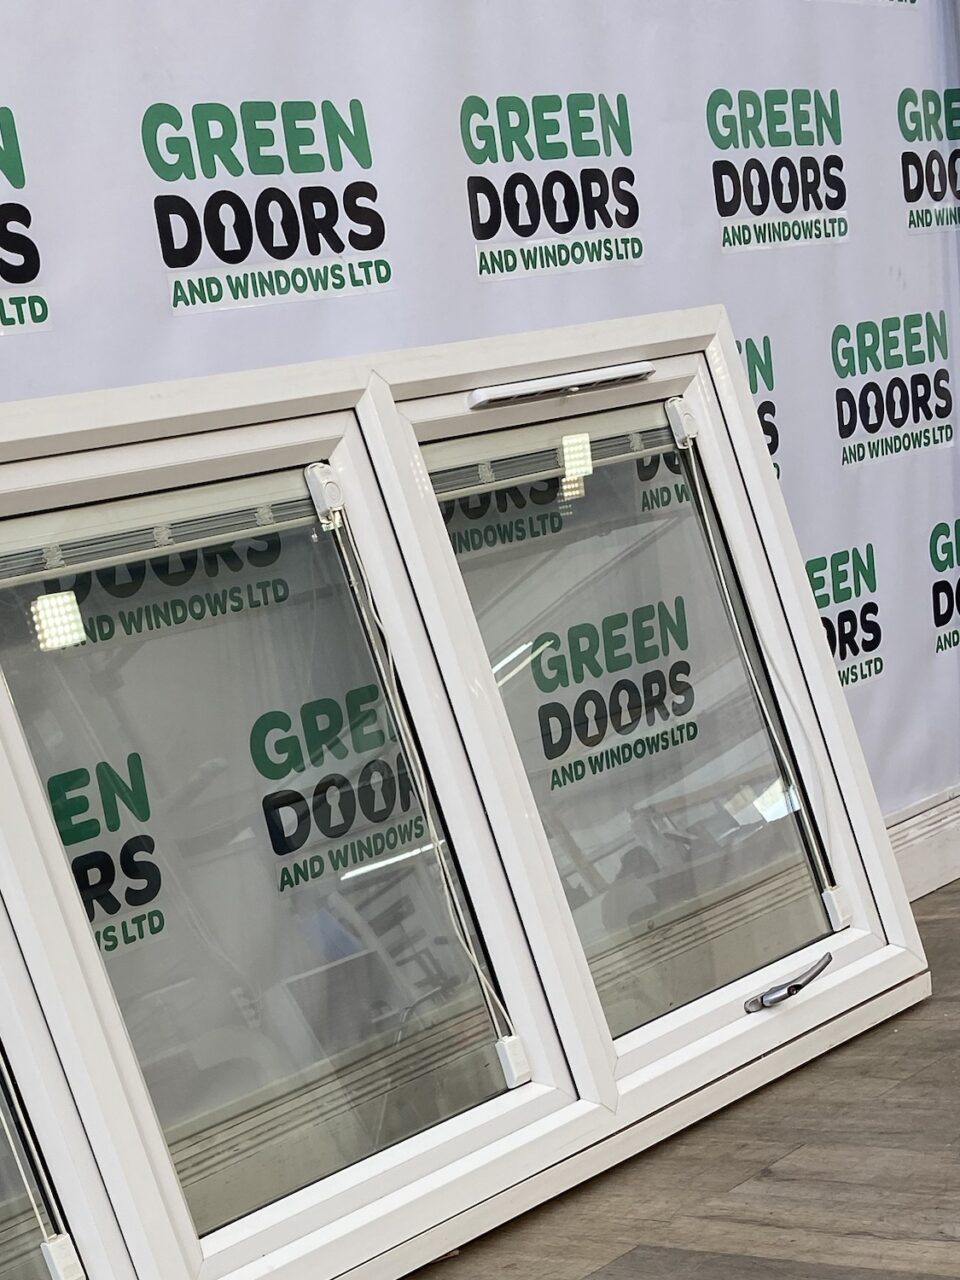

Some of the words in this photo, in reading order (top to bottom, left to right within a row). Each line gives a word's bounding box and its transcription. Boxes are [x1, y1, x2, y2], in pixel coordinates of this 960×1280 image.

[141, 98, 373, 182] GREEN
[460, 92, 632, 165] GREEN
[706, 88, 842, 150] GREEN
[466, 166, 639, 240] DOORS
[712, 154, 847, 217] DOORS
[153, 181, 386, 268] DOORS
[722, 224, 752, 247] AND
[753, 219, 822, 244] WINDOWS
[823, 217, 848, 238] LTD
[909, 209, 932, 229] AND
[172, 276, 223, 308] AND
[226, 264, 345, 300] WINDOWS
[348, 259, 391, 287] LTD
[478, 249, 518, 276] AND
[519, 238, 614, 270] WINDOWS
[615, 237, 643, 260] LTD
[831, 310, 949, 379] GREEN
[835, 368, 953, 439] DOORS
[841, 443, 866, 466] AND
[867, 428, 930, 459] WINDOWS
[932, 424, 953, 445] LTD
[528, 512, 563, 538] LTD
[642, 486, 672, 512] AND
[118, 586, 244, 636] WINDOWS
[247, 578, 290, 609] LTD
[530, 595, 689, 694] GREEN
[860, 656, 884, 680] LTD
[936, 629, 960, 653] AND
[537, 660, 695, 760] DOORS
[550, 759, 585, 791] AND
[588, 731, 670, 775] WINDOWS
[671, 721, 698, 747] LTD
[279, 855, 325, 892] AND
[327, 815, 425, 871] WINDOWS
[121, 909, 164, 945] LTD
